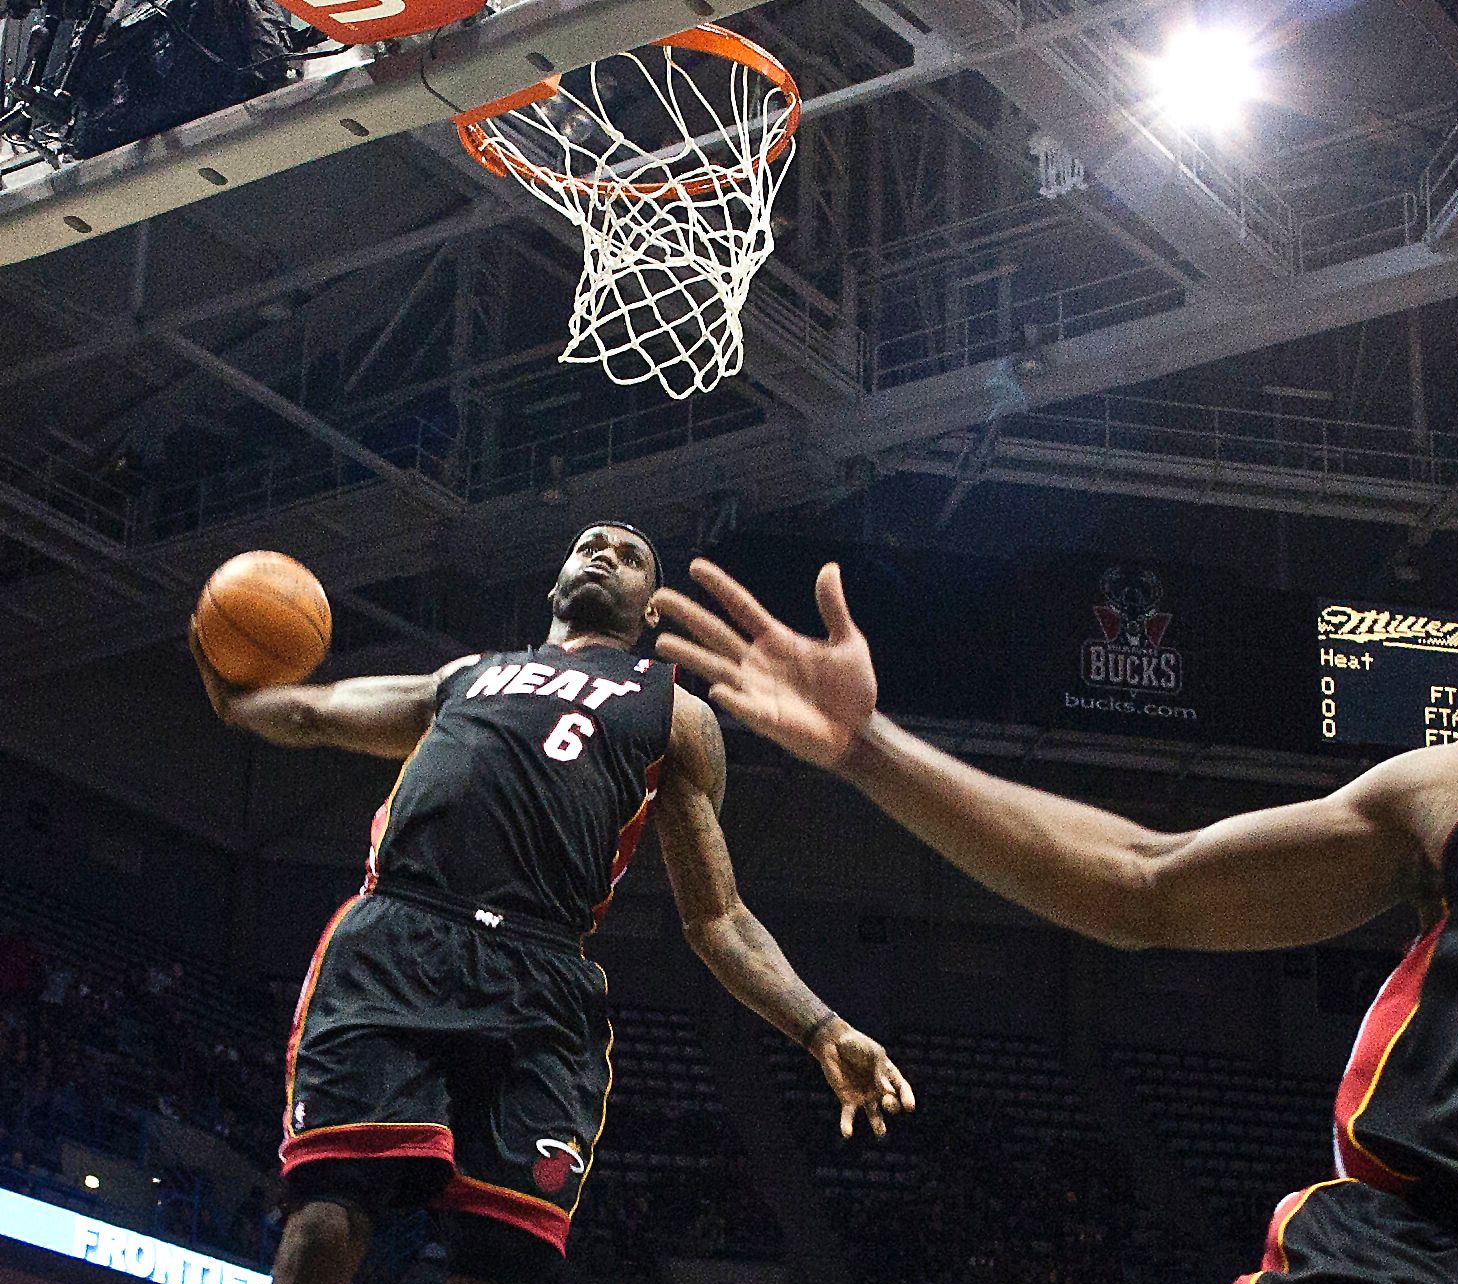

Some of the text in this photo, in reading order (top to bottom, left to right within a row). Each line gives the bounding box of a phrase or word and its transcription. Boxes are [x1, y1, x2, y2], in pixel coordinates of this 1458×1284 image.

[1089, 646, 1176, 689] BUCKS
[1320, 648, 1374, 671] Heat
[464, 661, 642, 711] HEAT
[1321, 676, 1335, 695] 0
[1430, 685, 1457, 705] FT
[1065, 691, 1198, 721] bucks.com
[1322, 699, 1336, 718] 0
[542, 710, 596, 763] 6
[1322, 719, 1336, 738] 0
